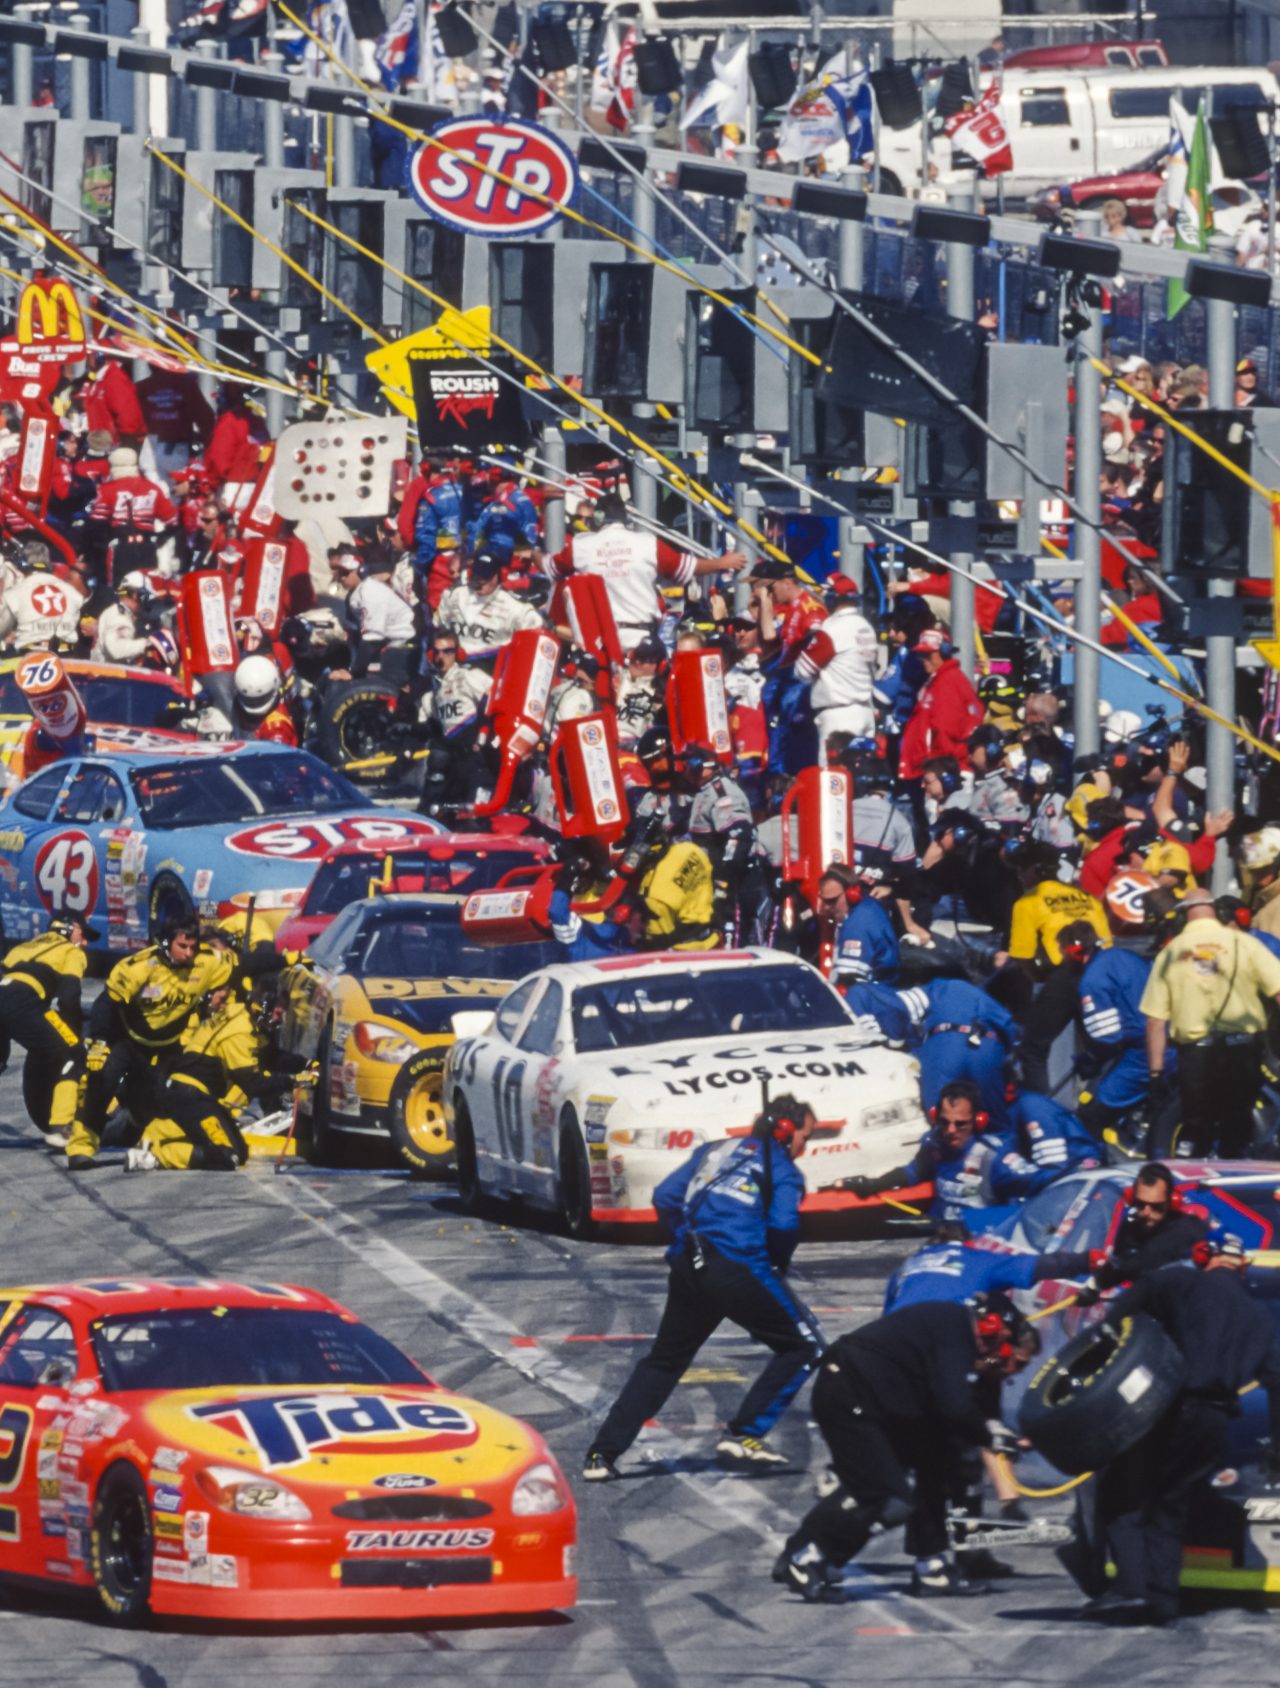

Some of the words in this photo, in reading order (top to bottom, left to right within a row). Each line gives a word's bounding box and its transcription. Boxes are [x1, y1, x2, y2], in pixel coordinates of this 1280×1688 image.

[429, 133, 552, 214] STP
[430, 377, 499, 393] ROUSH
[25, 660, 55, 686] 76
[254, 819, 408, 855] STP
[39, 838, 95, 912] 43
[1116, 880, 1145, 910] 76
[609, 1038, 886, 1078] LYCOS
[662, 1061, 868, 1097] LYCOS.COM
[665, 1129, 695, 1150] 10
[811, 1140, 862, 1157] PRIX
[183, 1394, 475, 1471] Tide
[382, 1477, 426, 1488] Ford
[243, 1489, 279, 1507] 32
[347, 1529, 494, 1550] TAURUS
